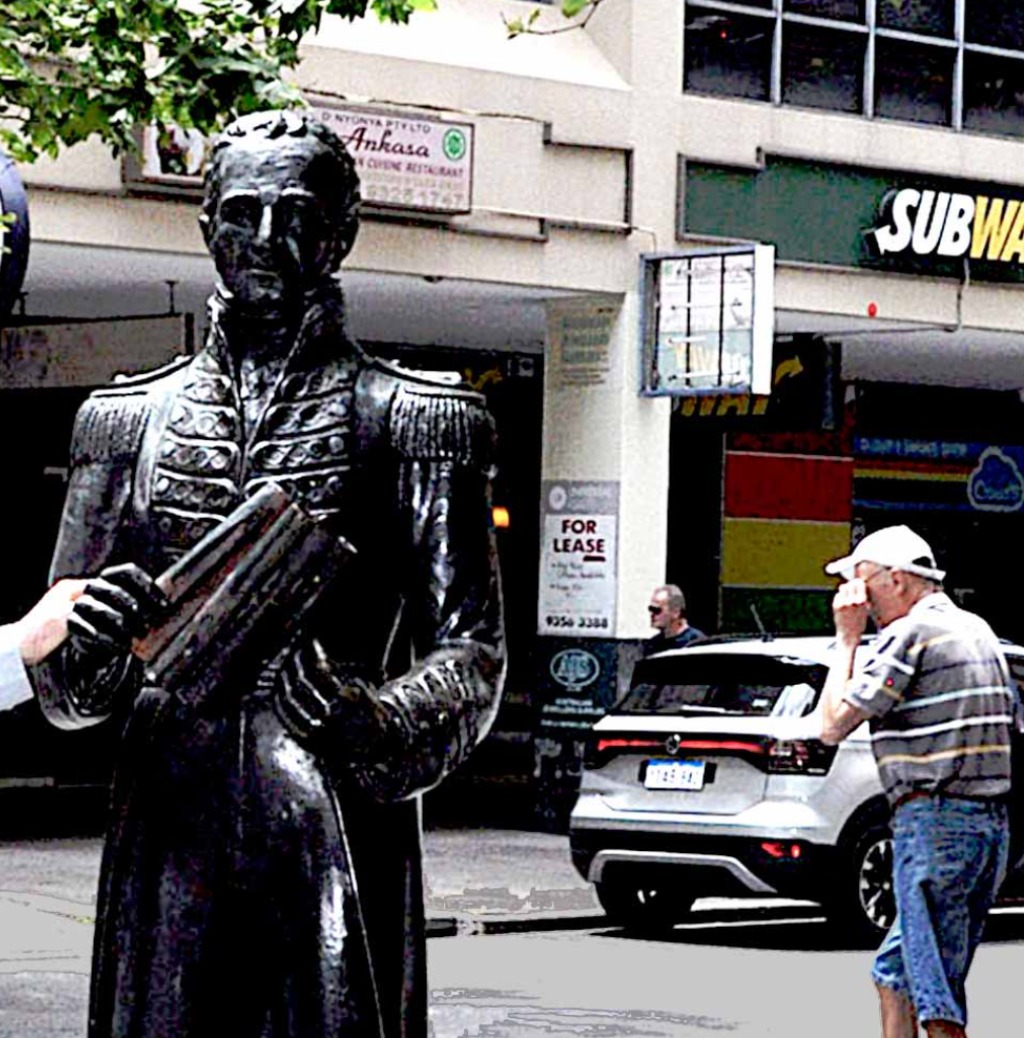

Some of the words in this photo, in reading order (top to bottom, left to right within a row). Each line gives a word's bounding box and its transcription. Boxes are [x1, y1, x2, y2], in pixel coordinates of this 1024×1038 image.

[341, 127, 430, 158] Ankasa
[406, 163, 464, 178] RESTAURANT
[561, 519, 597, 535] FOR
[553, 538, 606, 553] LEASE
